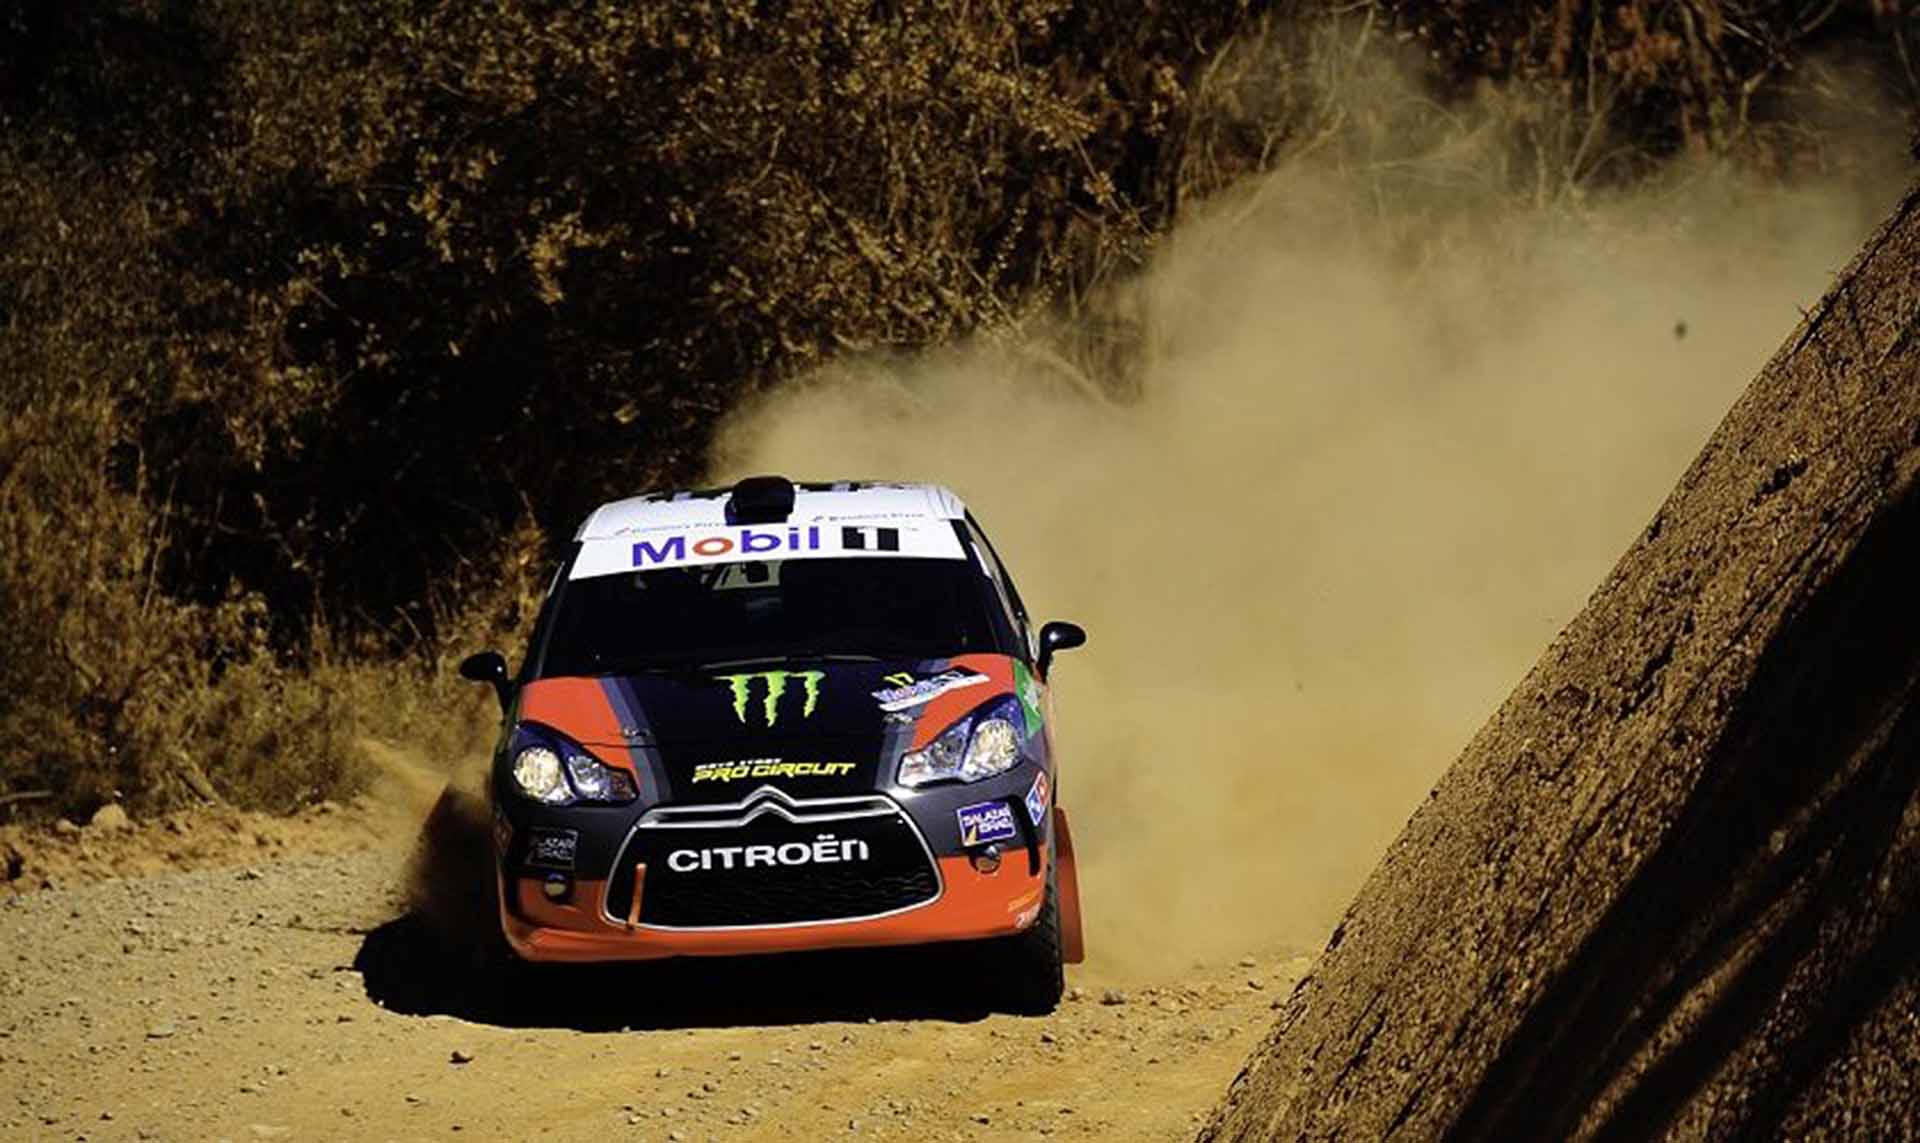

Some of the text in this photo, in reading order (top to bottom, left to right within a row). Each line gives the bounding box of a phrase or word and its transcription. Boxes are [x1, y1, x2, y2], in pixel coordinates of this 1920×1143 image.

[632, 525, 819, 567] Mobil
[692, 766, 751, 783] PRO
[752, 762, 857, 778] CIRCUIT
[667, 834, 869, 872] CITROËN
